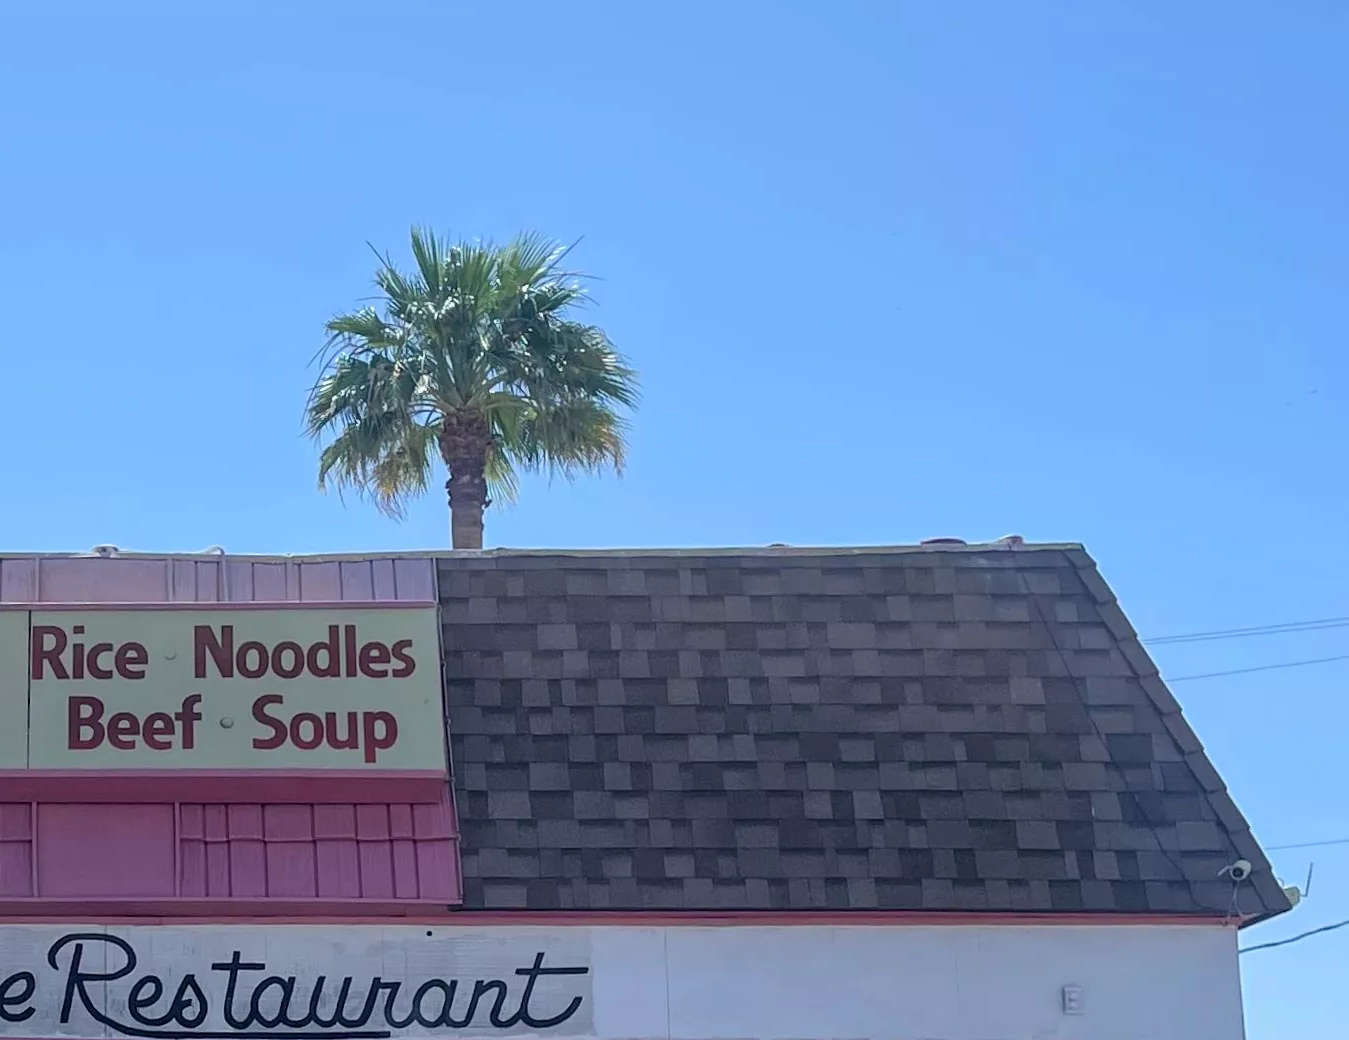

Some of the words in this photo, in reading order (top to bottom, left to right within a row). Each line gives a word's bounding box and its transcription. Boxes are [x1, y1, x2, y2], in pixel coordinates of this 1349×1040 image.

[31, 625, 149, 680] Rice
[193, 624, 417, 679] Noodles
[67, 694, 202, 750] Beef
[252, 694, 398, 764] Soup
[47, 932, 590, 1040] Restaurant
